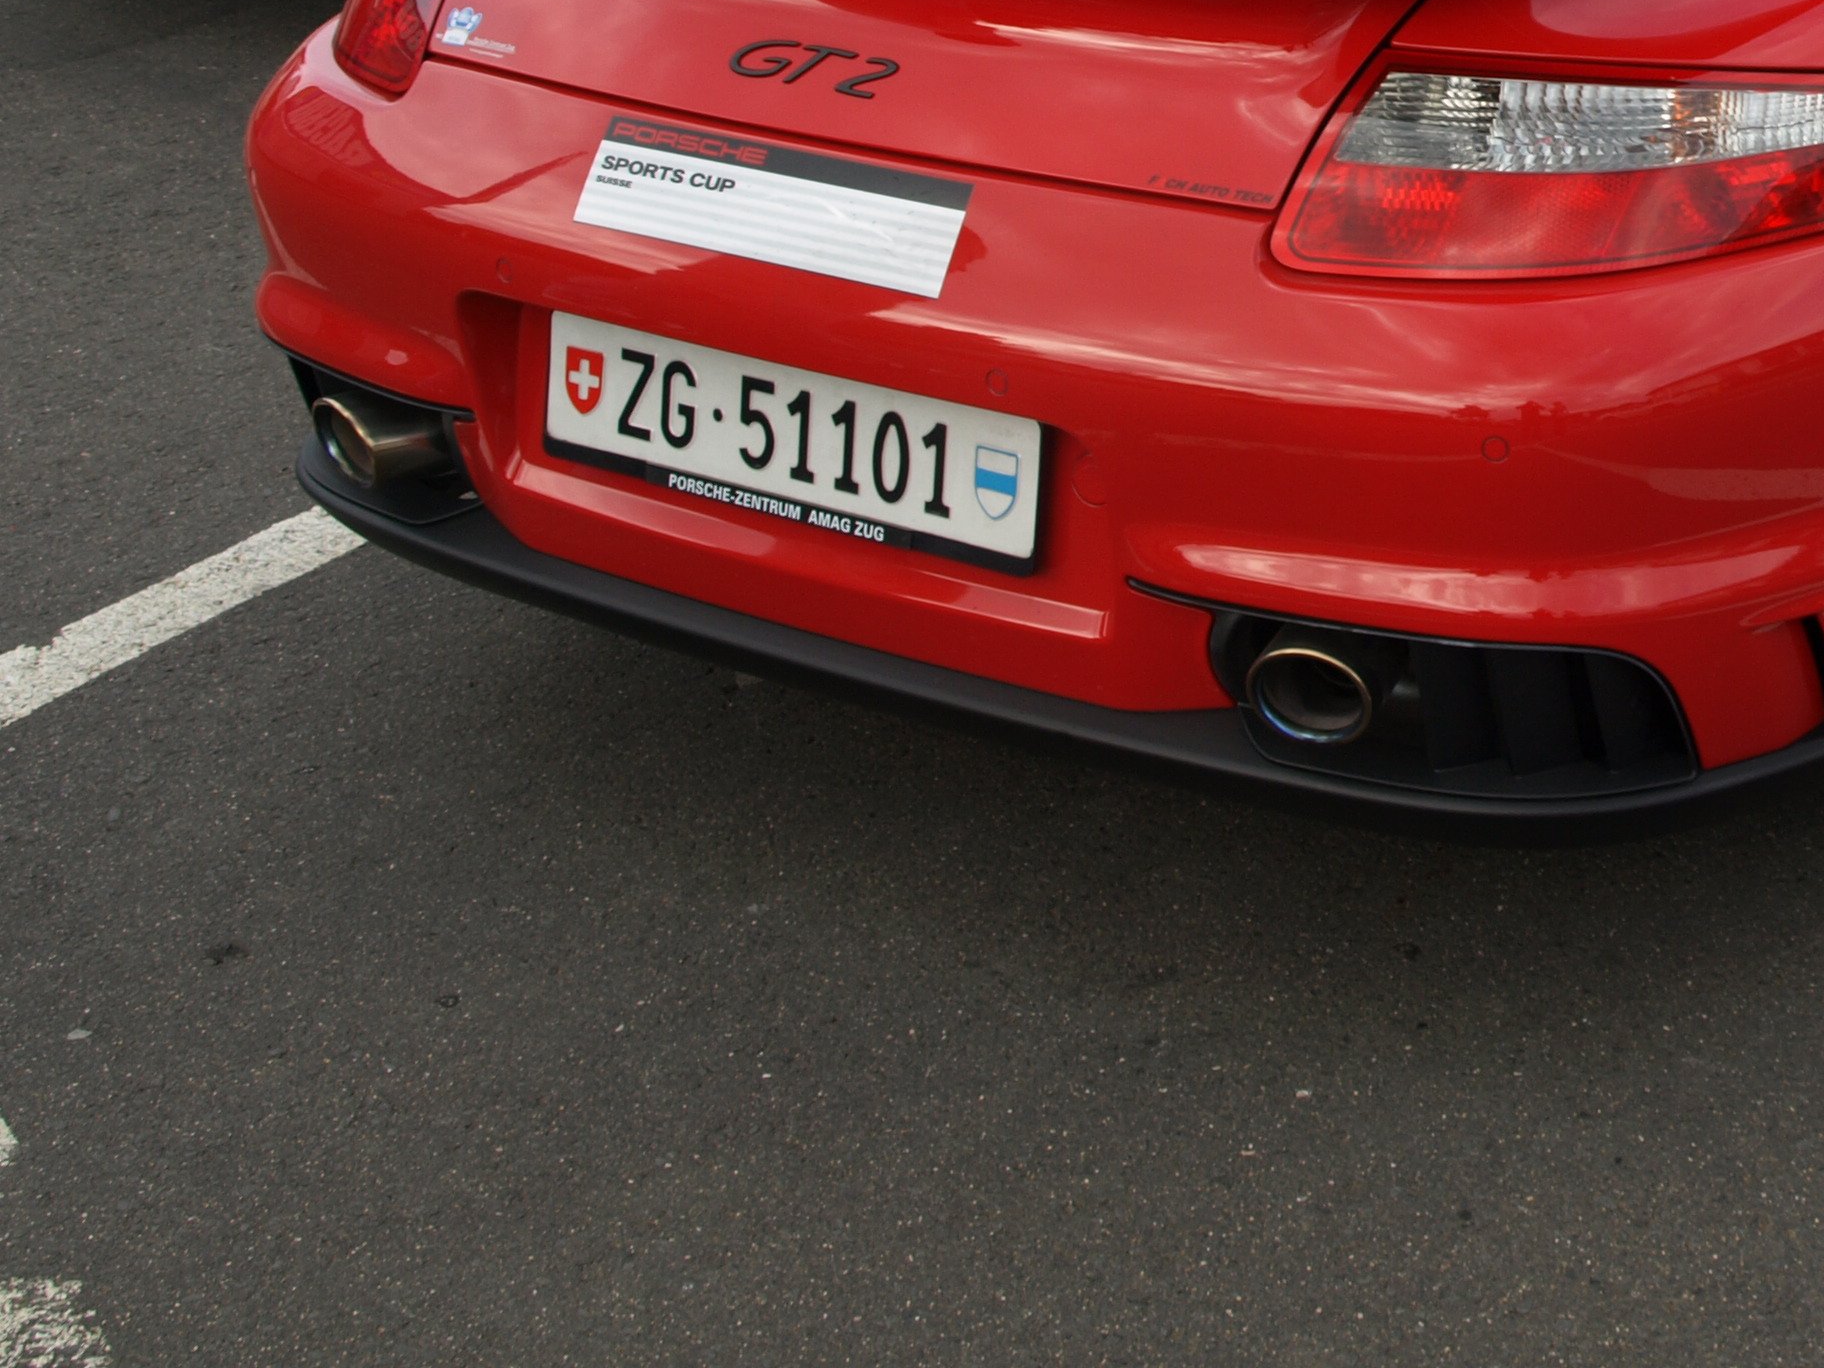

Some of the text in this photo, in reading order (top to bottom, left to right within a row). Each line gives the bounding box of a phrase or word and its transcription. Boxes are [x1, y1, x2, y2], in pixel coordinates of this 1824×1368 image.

[612, 122, 769, 167] PORSCHE
[596, 175, 633, 190] SUISSE
[601, 155, 736, 193] SPORTS CUP
[668, 473, 885, 542] PORSCHE-ZENTRUM AMAG ZUG
